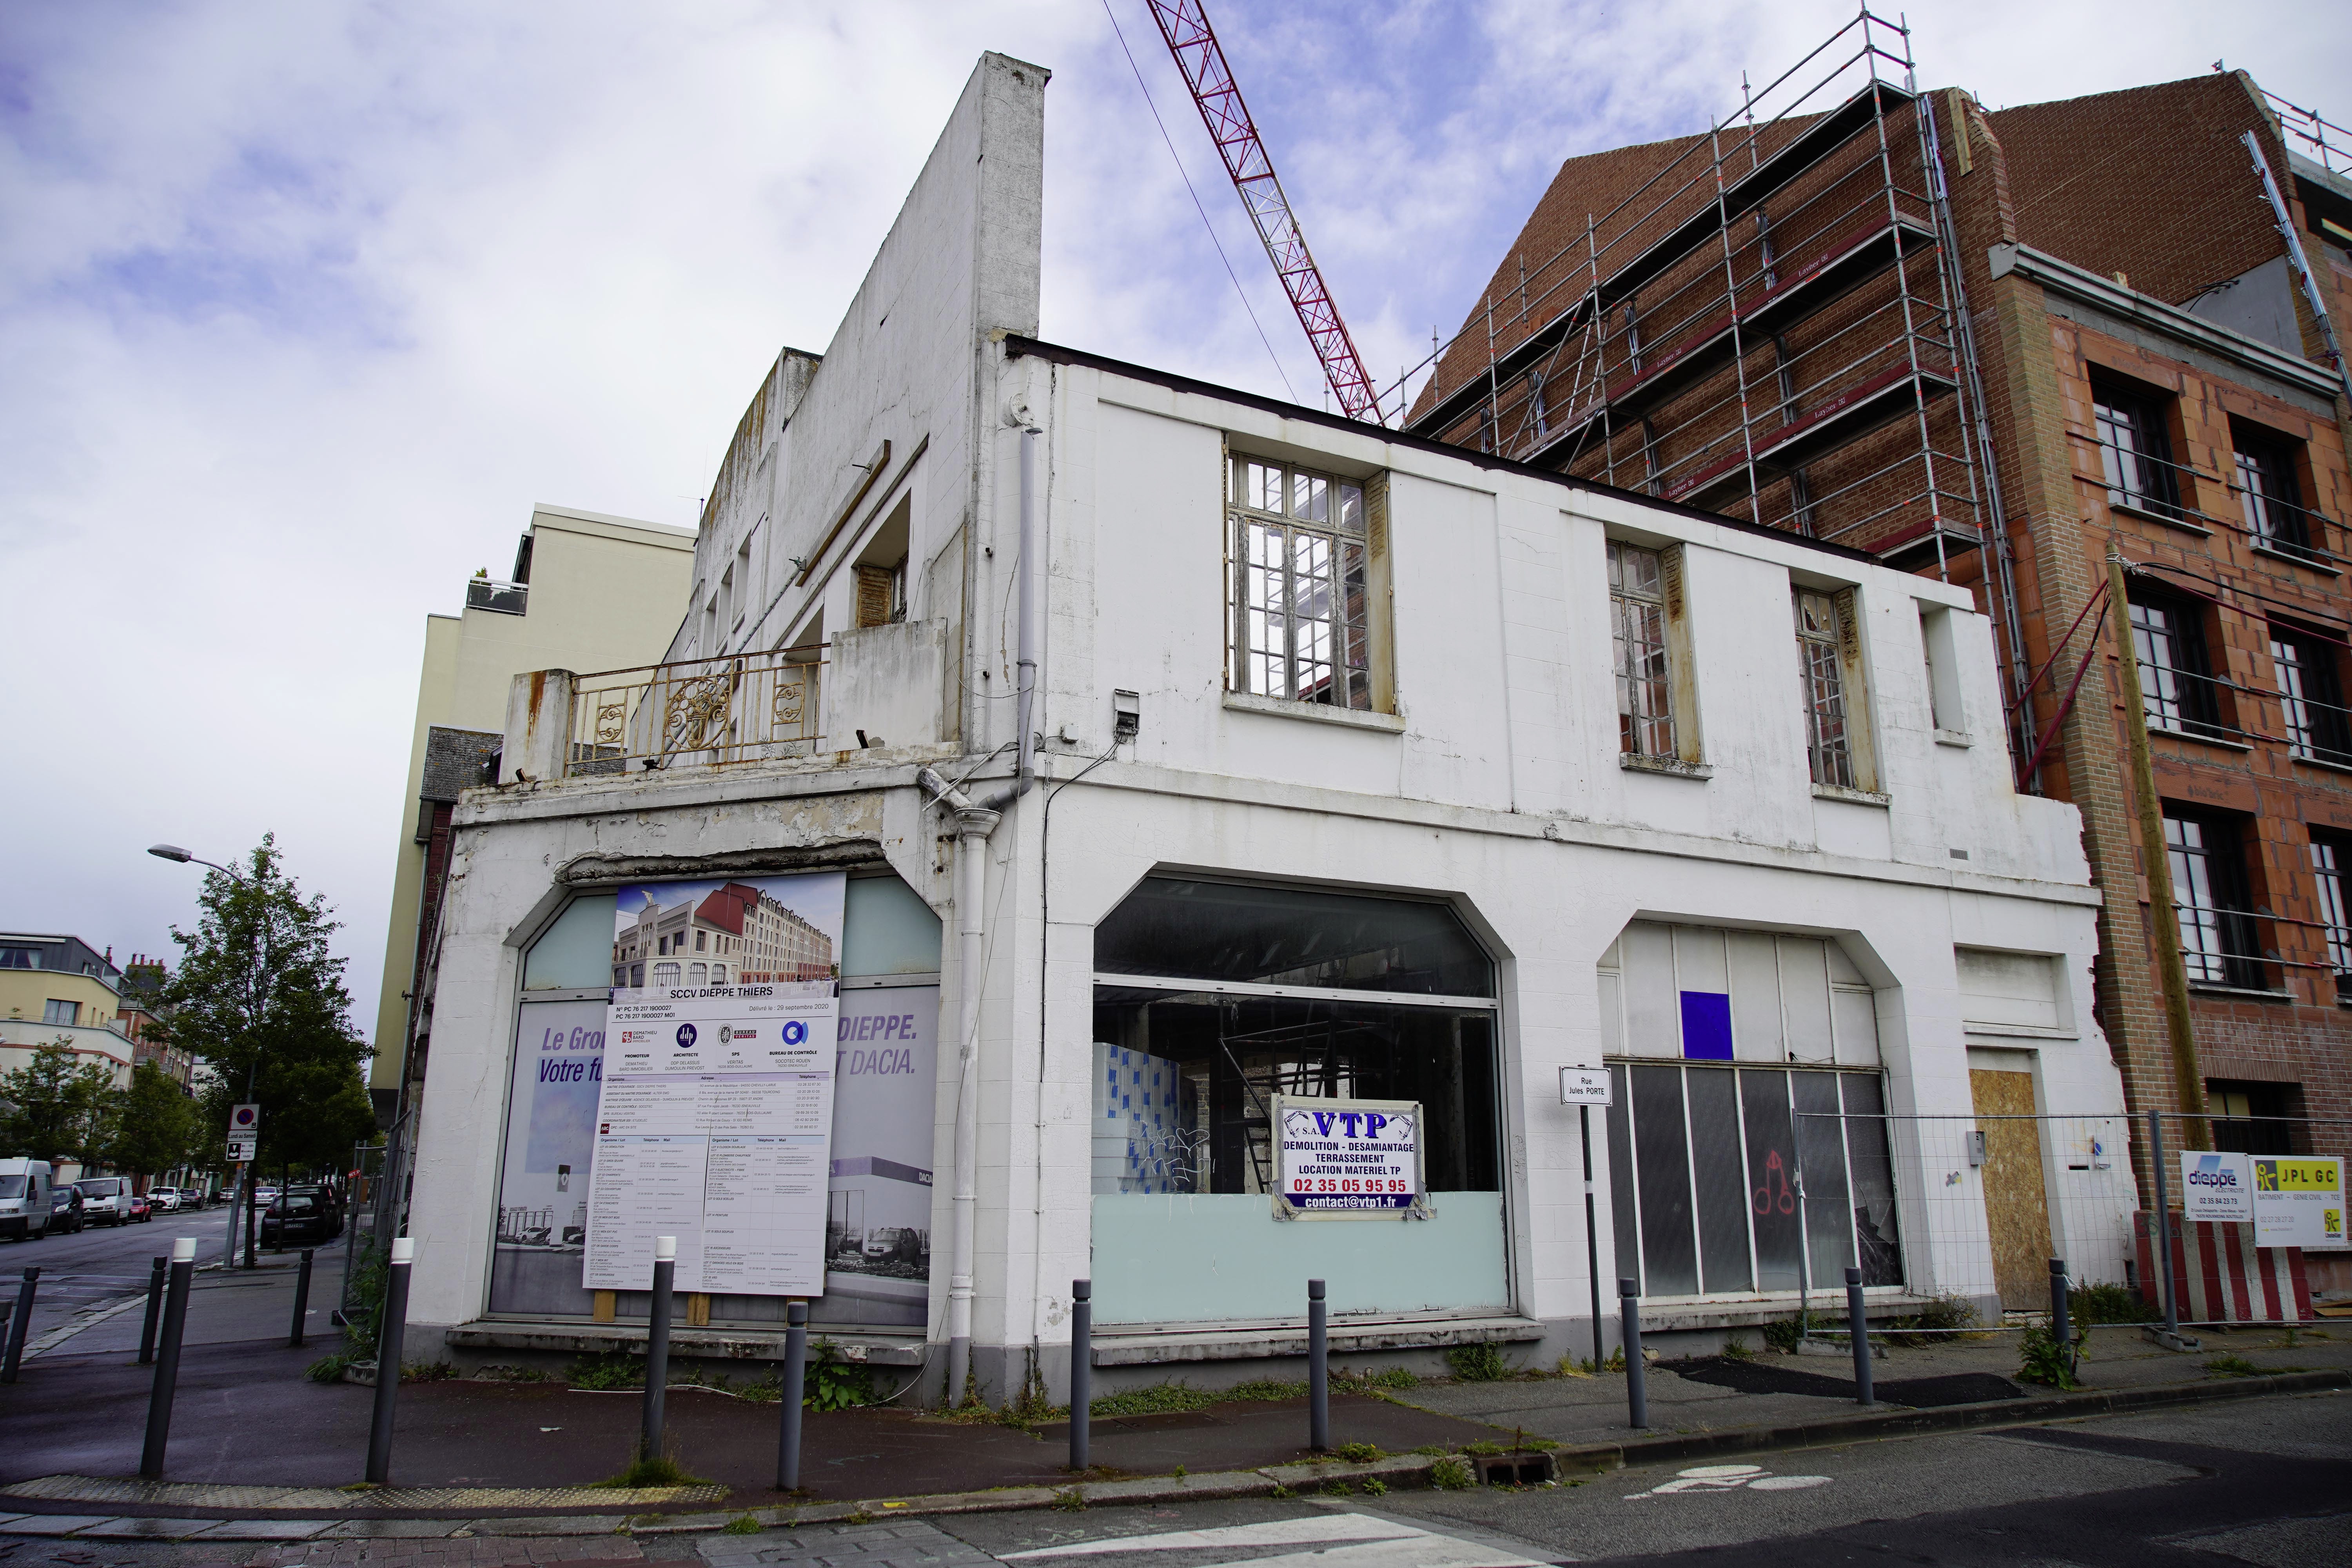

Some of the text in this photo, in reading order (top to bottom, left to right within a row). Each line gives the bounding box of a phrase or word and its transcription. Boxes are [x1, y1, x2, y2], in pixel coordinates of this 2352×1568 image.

[1798, 260, 1819, 277] Layher
[1657, 354, 1674, 367] Layher
[1815, 403, 1836, 418] Layher
[1668, 484, 1687, 497] Layher
[670, 987, 773, 998] SCCV DIEPPE THIERS
[837, 1014, 916, 1042] DIEPPE.
[542, 1028, 564, 1051] Le
[680, 1027, 693, 1045] ddp
[850, 1049, 915, 1075] DACIA.
[540, 1059, 584, 1082] Votre
[1302, 1112, 1387, 1139] S.A. VTP
[1284, 1141, 1339, 1151] DEMOLITION
[1348, 1142, 1414, 1152] DESAMIANTAGE
[1315, 1154, 1384, 1163] TERRASSEMENT
[1299, 1165, 1401, 1175] LOCATION MATERIEL TP
[919, 1172, 933, 1183] DACIA
[2189, 1170, 2237, 1187] dieppe
[1294, 1179, 1406, 1192] 02 35 05 95 95
[1305, 1196, 1396, 1208] contact@vtp1.fr
